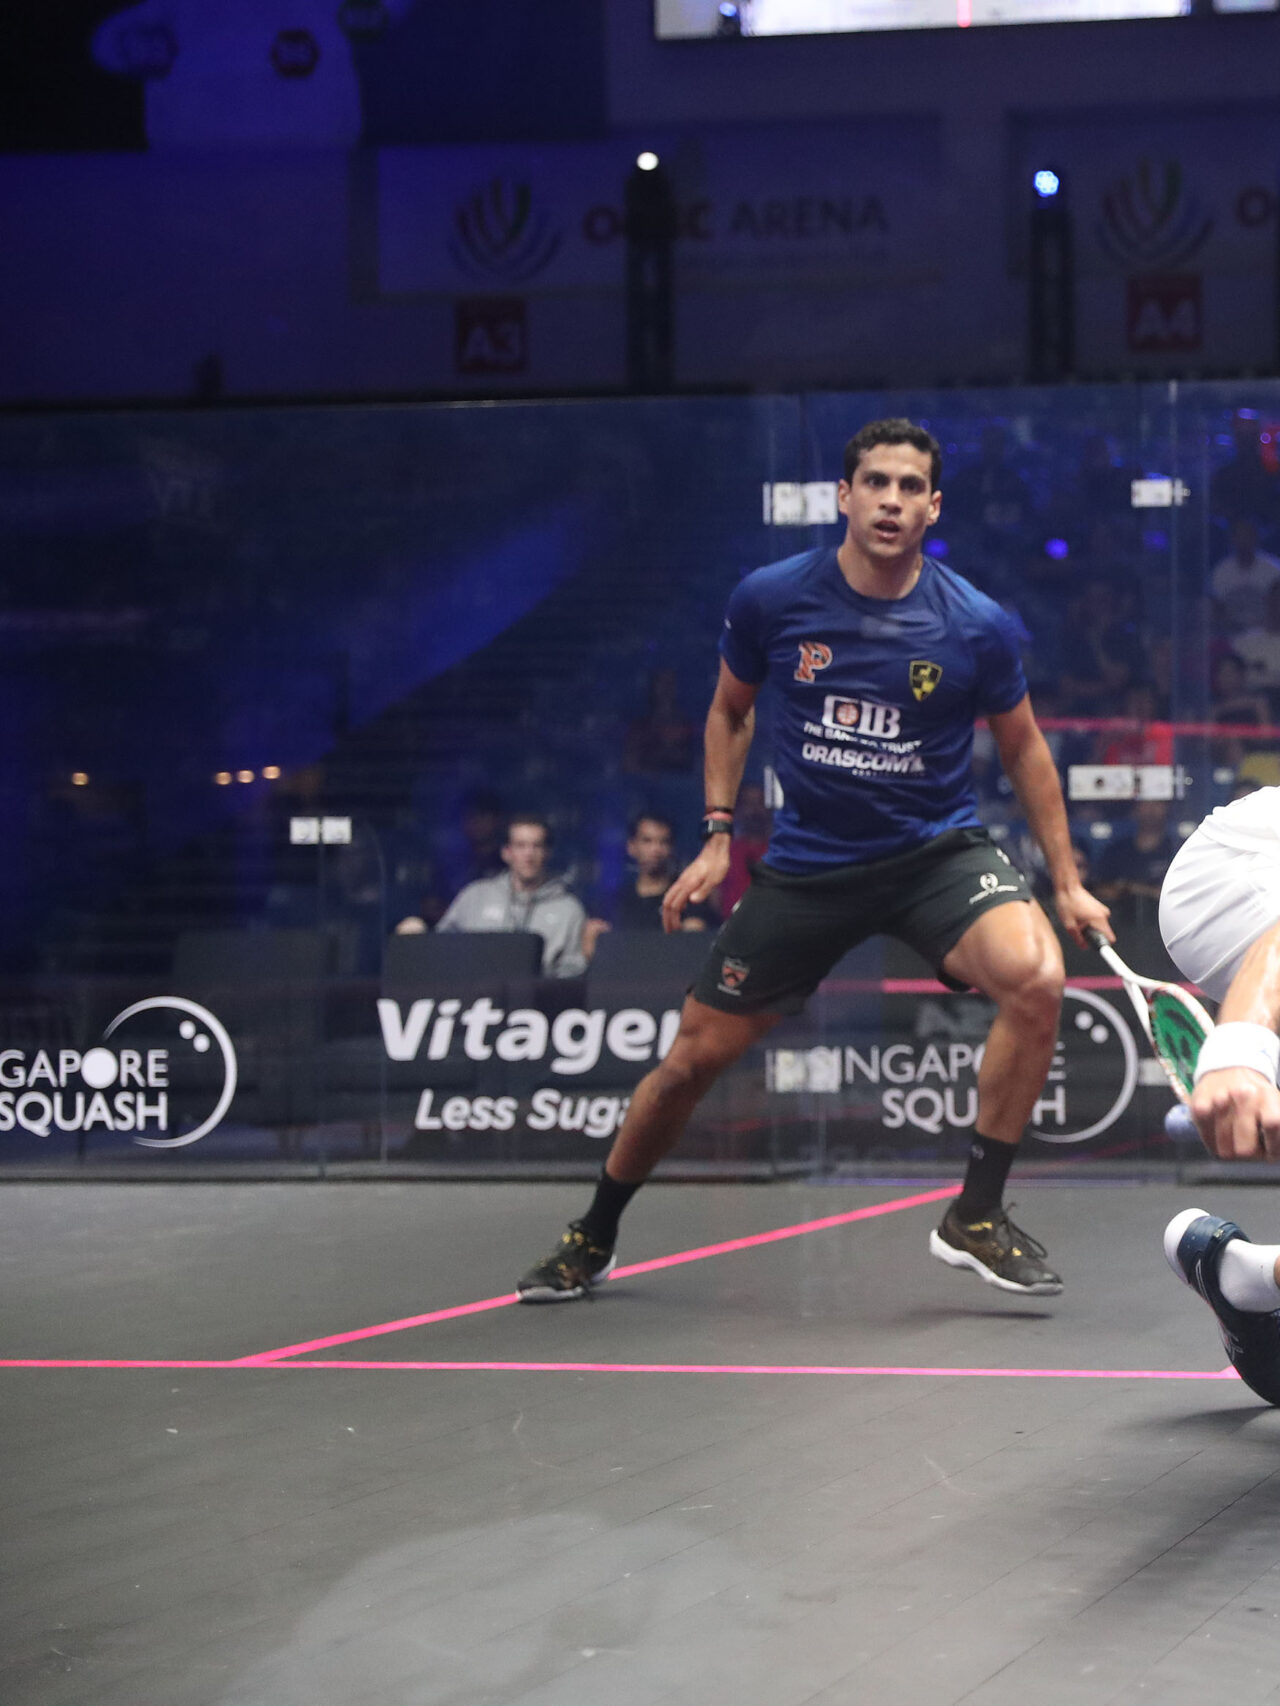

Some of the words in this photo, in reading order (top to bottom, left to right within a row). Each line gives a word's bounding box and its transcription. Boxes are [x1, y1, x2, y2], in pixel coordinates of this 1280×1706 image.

[730, 194, 890, 240] ARENA
[1137, 301, 1196, 338] A4
[794, 641, 833, 683] P
[822, 695, 901, 739] CIB
[802, 743, 911, 773] ORASCOM
[0, 1091, 168, 1138] SQUASH
[414, 1088, 519, 1131] Less
[527, 1088, 632, 1139] Sug
[881, 1087, 1066, 1134] SQUH
